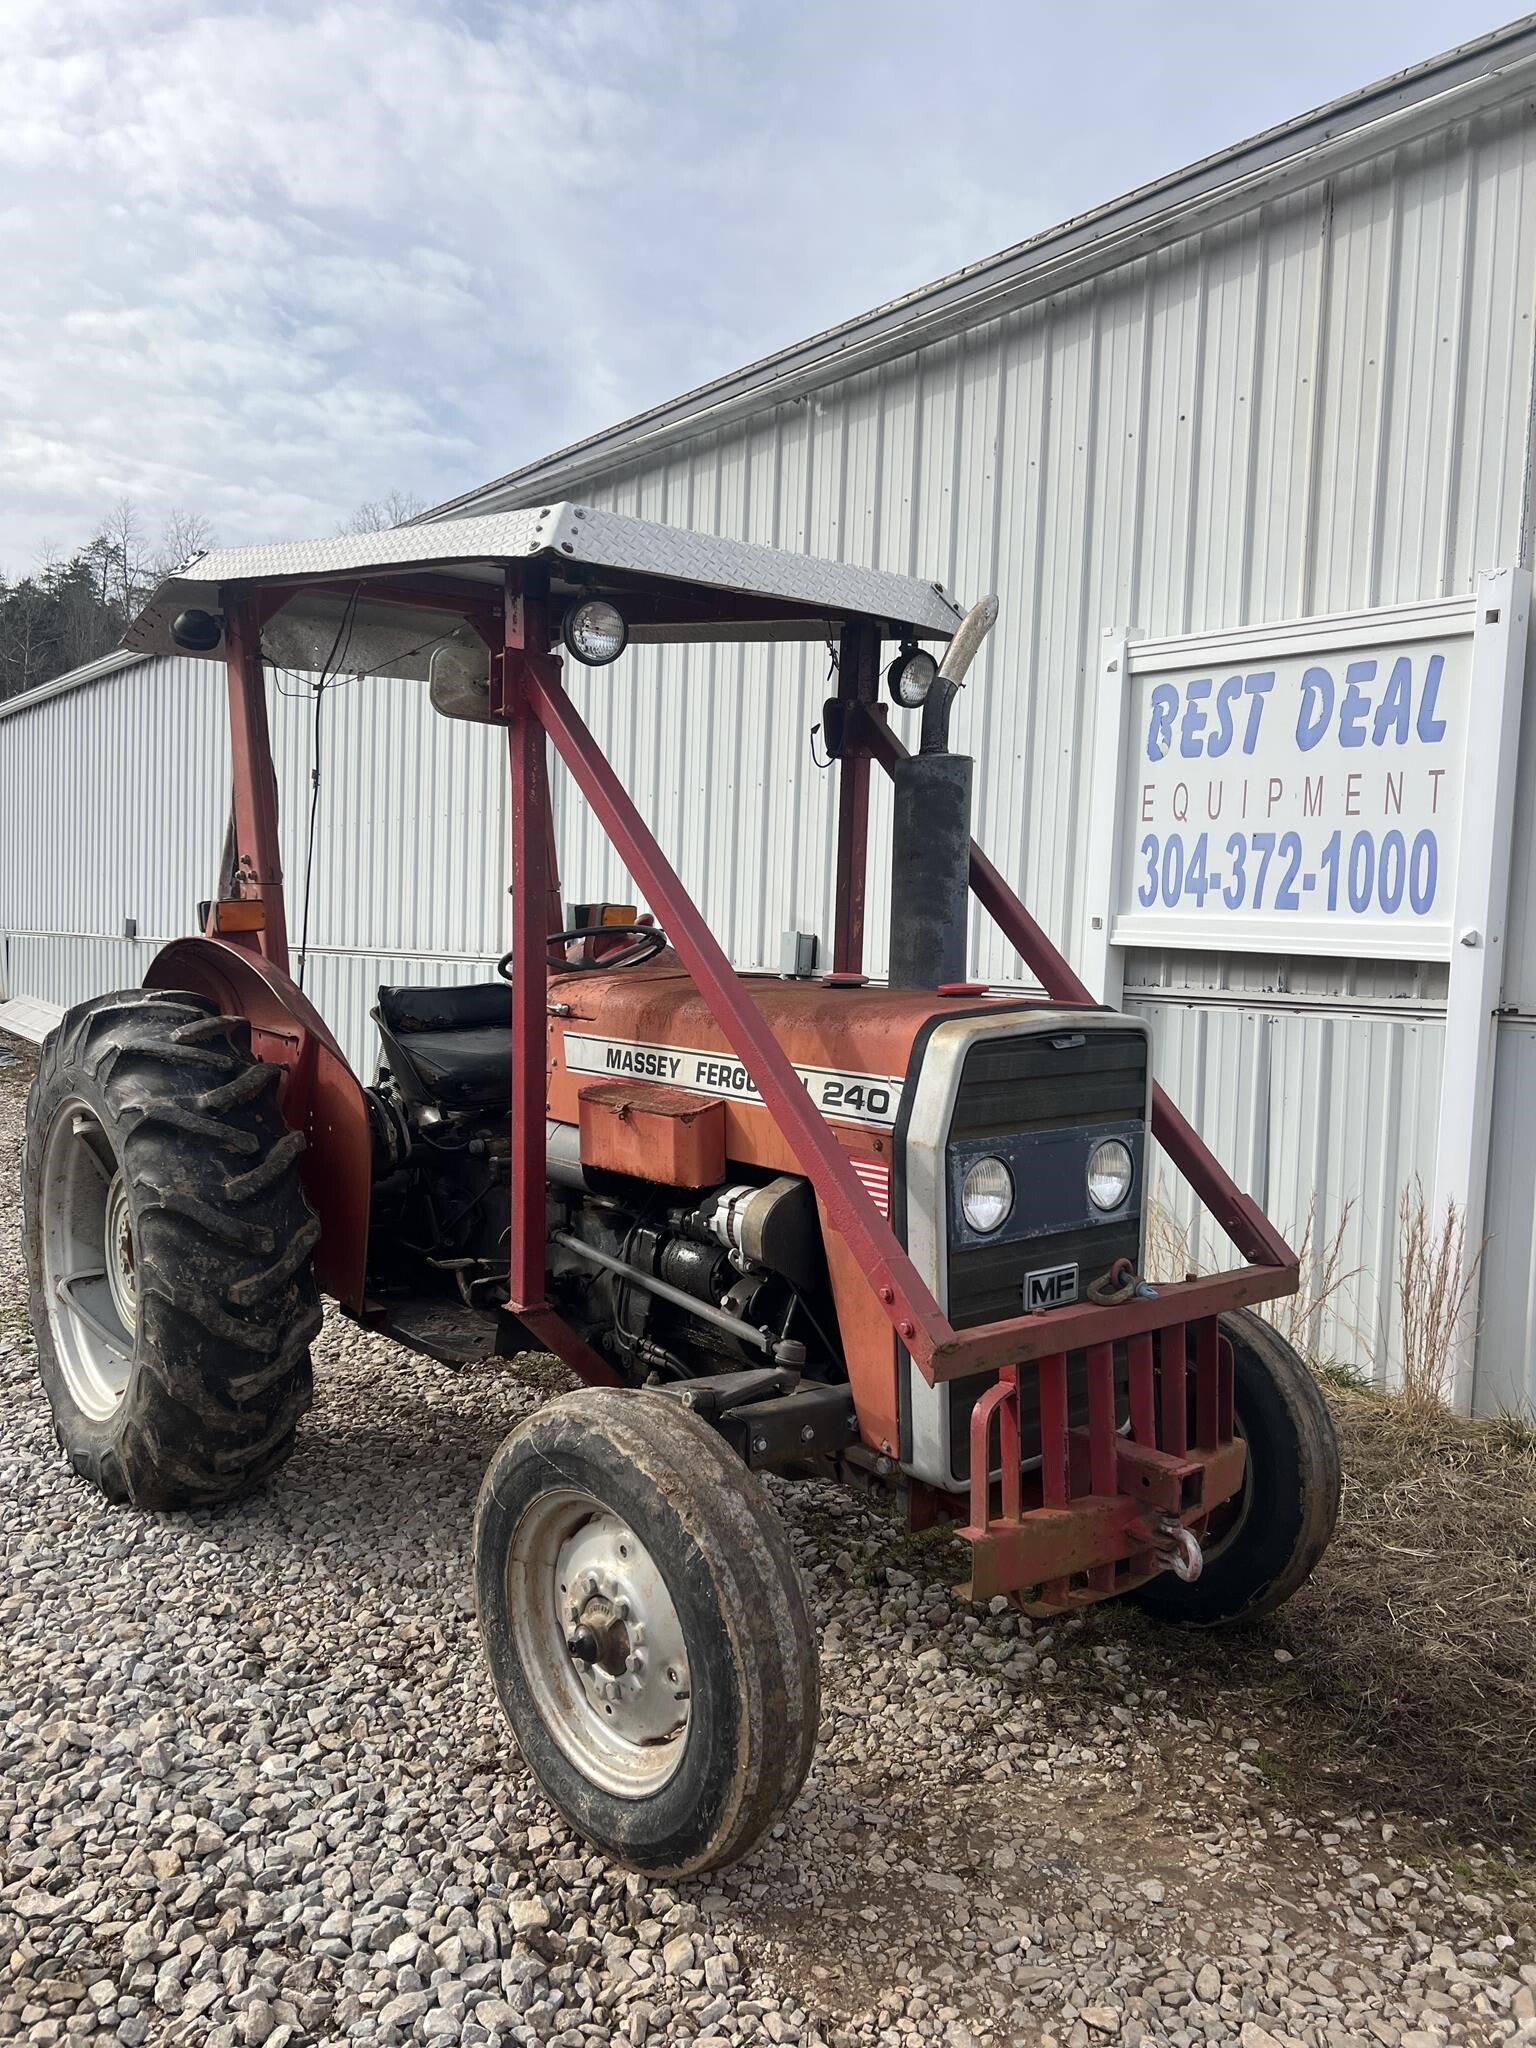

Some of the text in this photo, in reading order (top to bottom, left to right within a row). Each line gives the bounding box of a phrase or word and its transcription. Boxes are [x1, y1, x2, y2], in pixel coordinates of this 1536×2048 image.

[1146, 654, 1448, 763] BEST DEAL
[1141, 769, 1446, 823] EQUIPMENT
[1138, 828, 1438, 916] 304-372-1000
[606, 1048, 681, 1079] MASSEY
[822, 1081, 890, 1115] 240
[1031, 1272, 1075, 1305] MF
